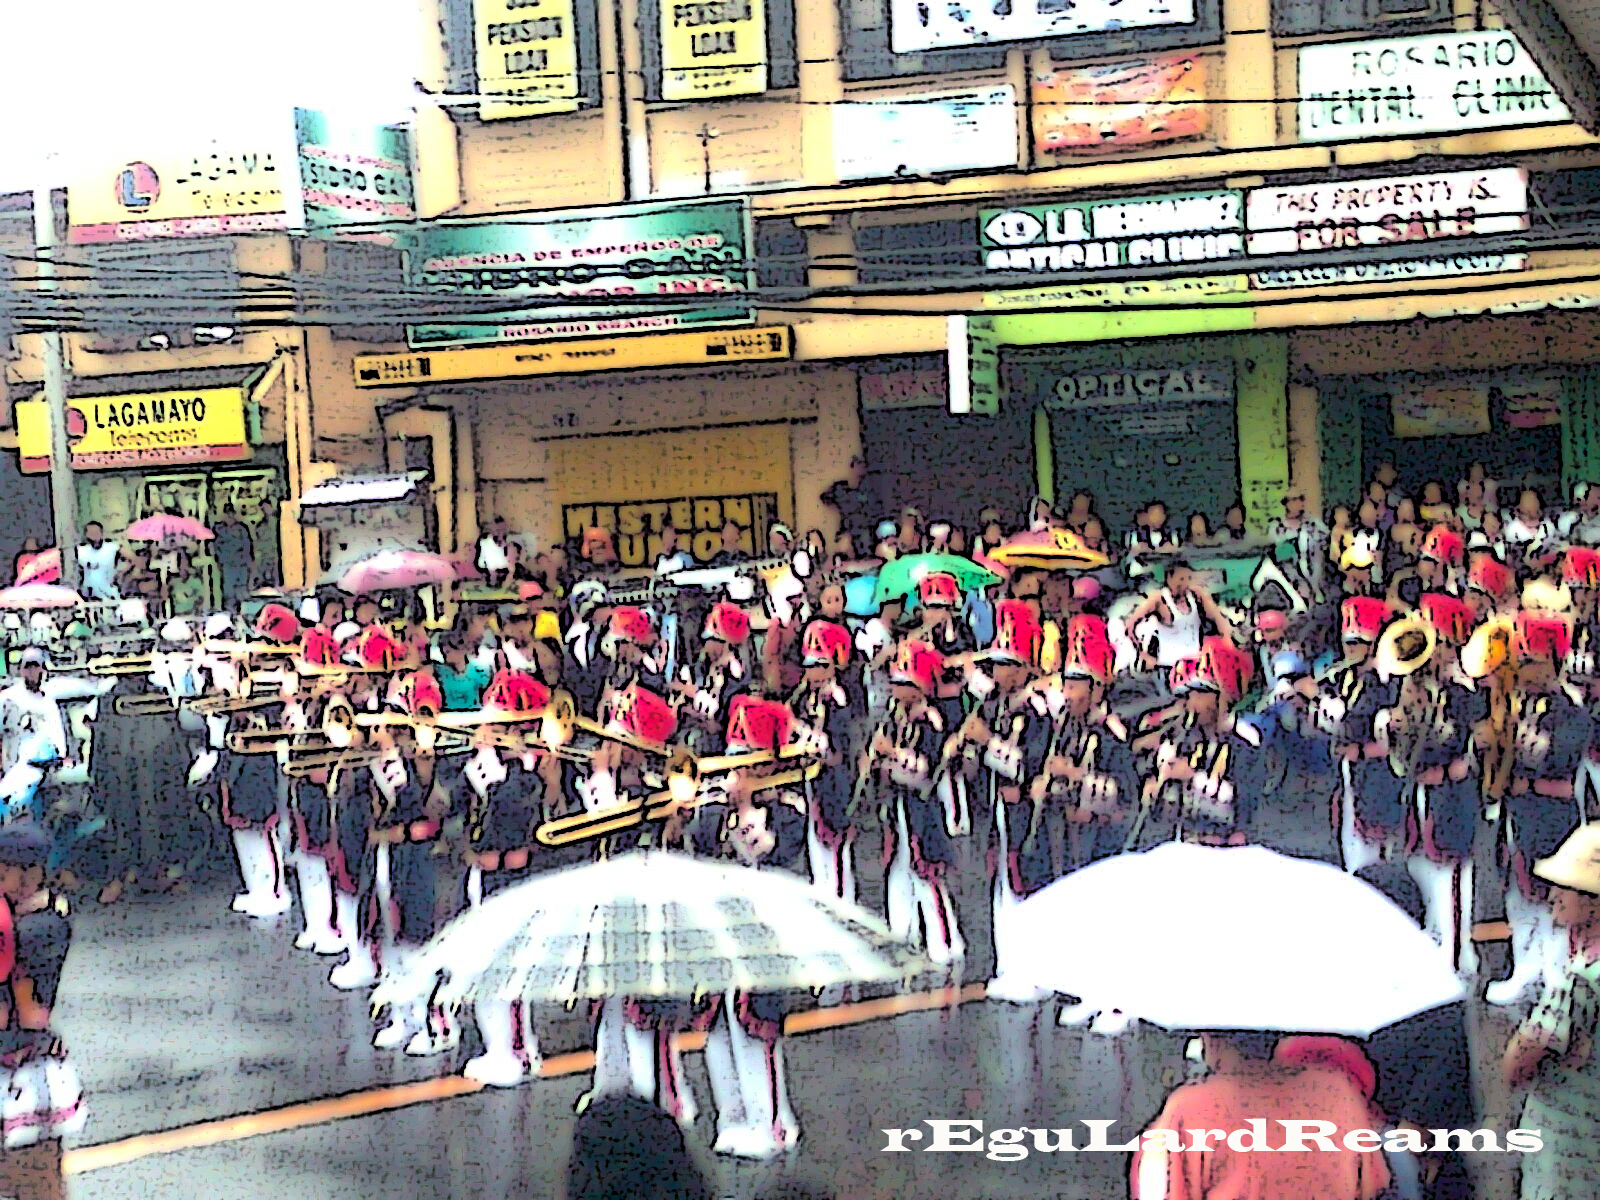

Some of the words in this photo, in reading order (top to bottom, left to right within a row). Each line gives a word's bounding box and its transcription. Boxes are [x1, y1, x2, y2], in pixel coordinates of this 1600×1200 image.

[1352, 38, 1515, 78] ROSARIO
[1275, 190, 1318, 212] THIS
[1331, 178, 1452, 210] PROPERTY
[1297, 217, 1361, 249] FOR
[1055, 368, 1210, 400] OPTICAL
[94, 396, 206, 428] LAGAMAYO
